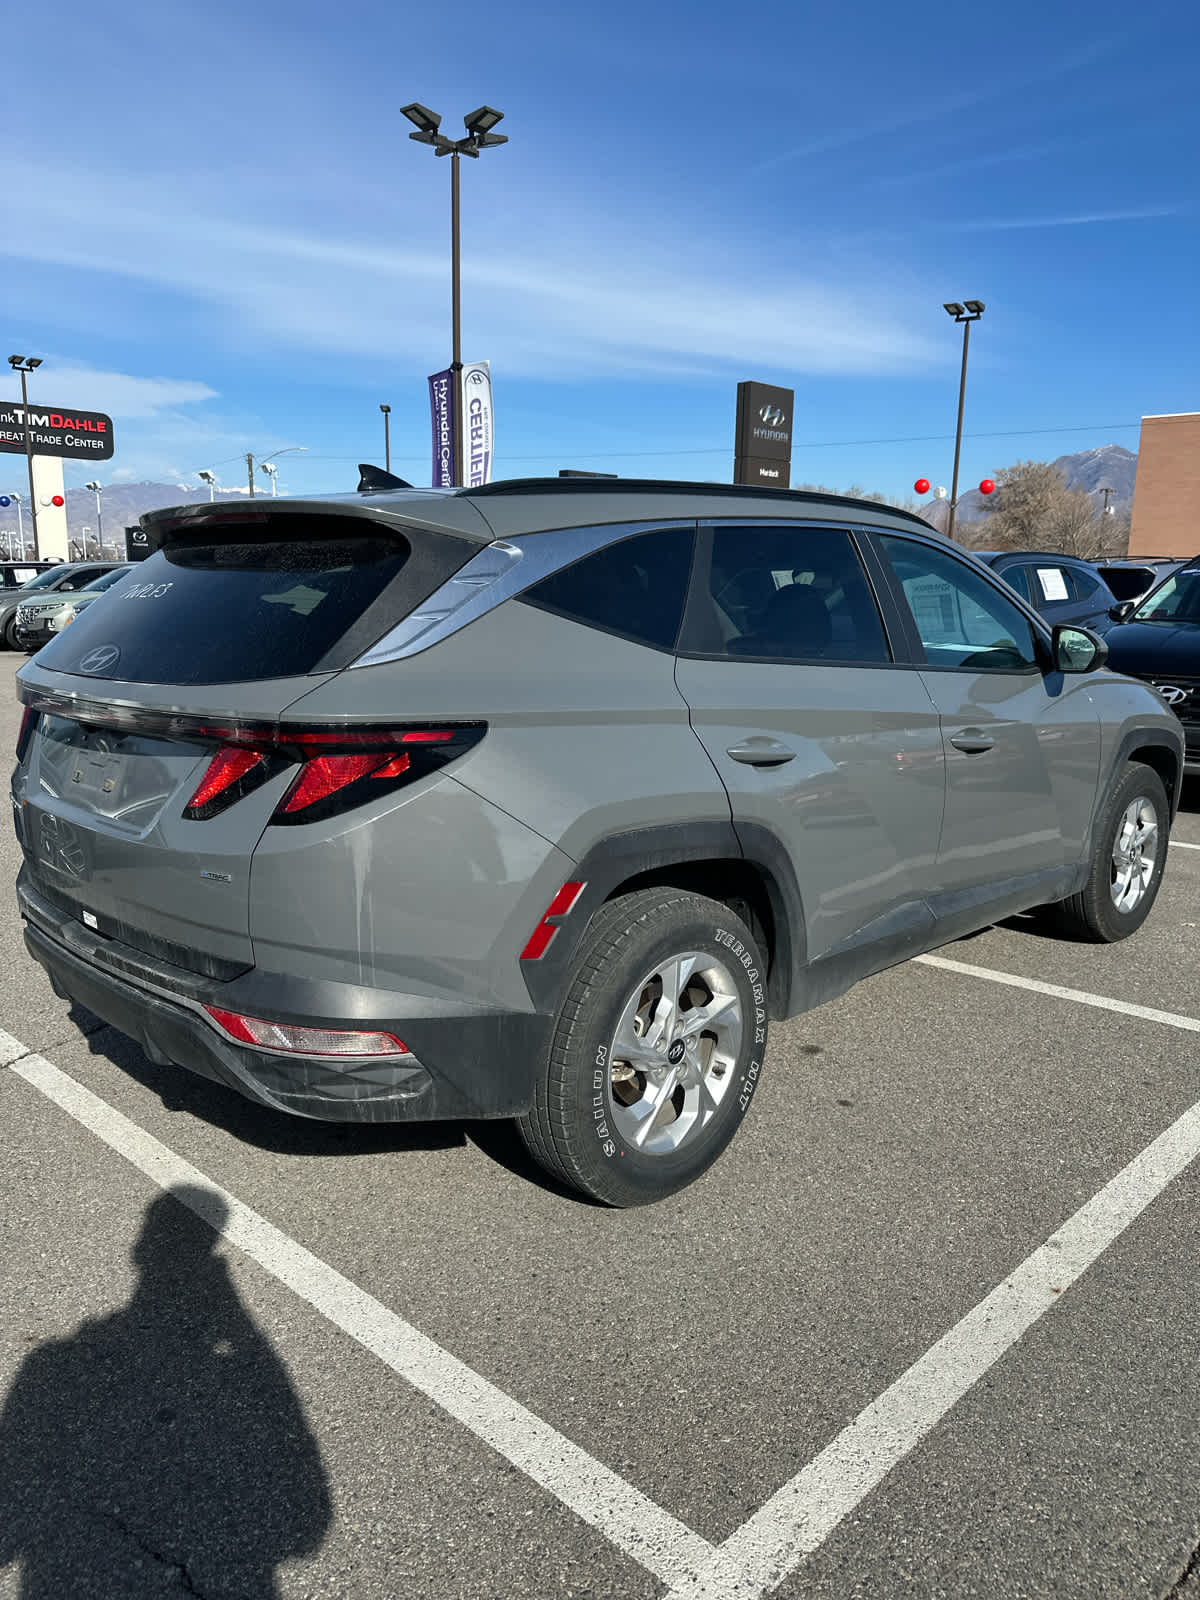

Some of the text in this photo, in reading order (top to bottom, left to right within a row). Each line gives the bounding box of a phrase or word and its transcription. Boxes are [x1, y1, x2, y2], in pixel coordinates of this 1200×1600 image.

[29, 430, 62, 446] TRADE
[65, 434, 104, 449] CENTER
[439, 379, 450, 446] Hyundai
[753, 427, 789, 442] HYUNDAI
[714, 928, 766, 1044] TERRAMAX
[593, 1045, 616, 1157] SAILUN
